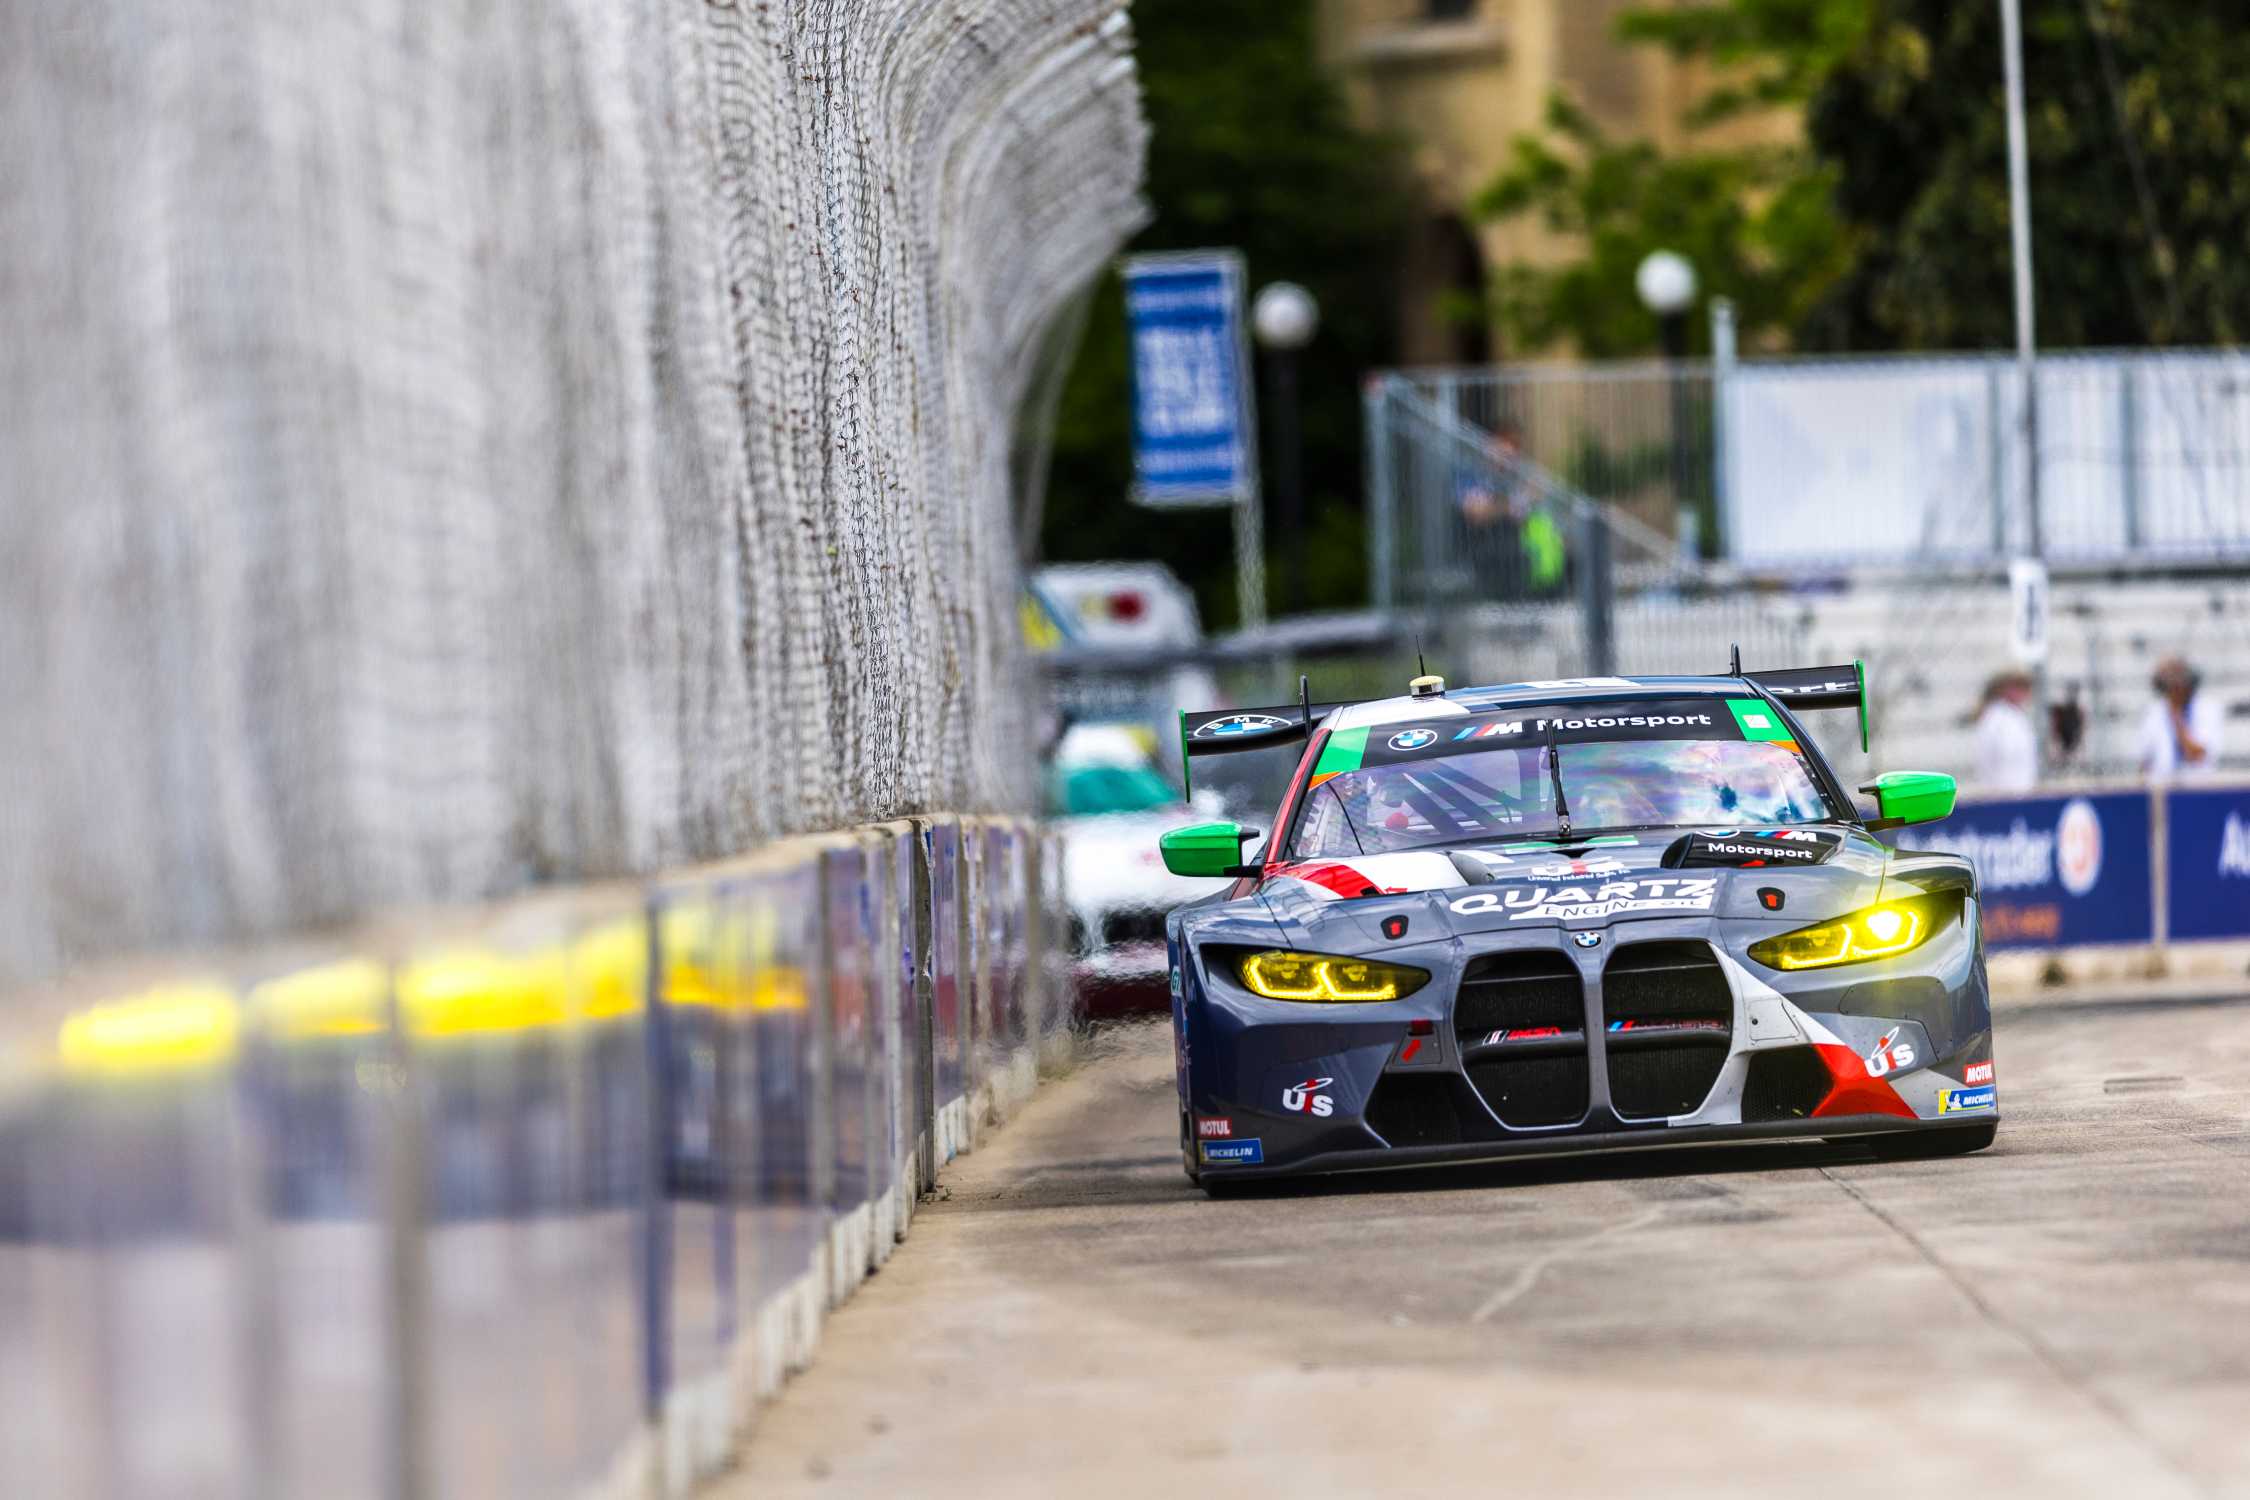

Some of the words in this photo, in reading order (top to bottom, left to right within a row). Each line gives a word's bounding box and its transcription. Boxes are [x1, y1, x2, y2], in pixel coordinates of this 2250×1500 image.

[1536, 714, 1712, 731] Motorsport
[1707, 842, 1814, 859] Motorsport
[1450, 878, 1718, 916] QUARTZ
